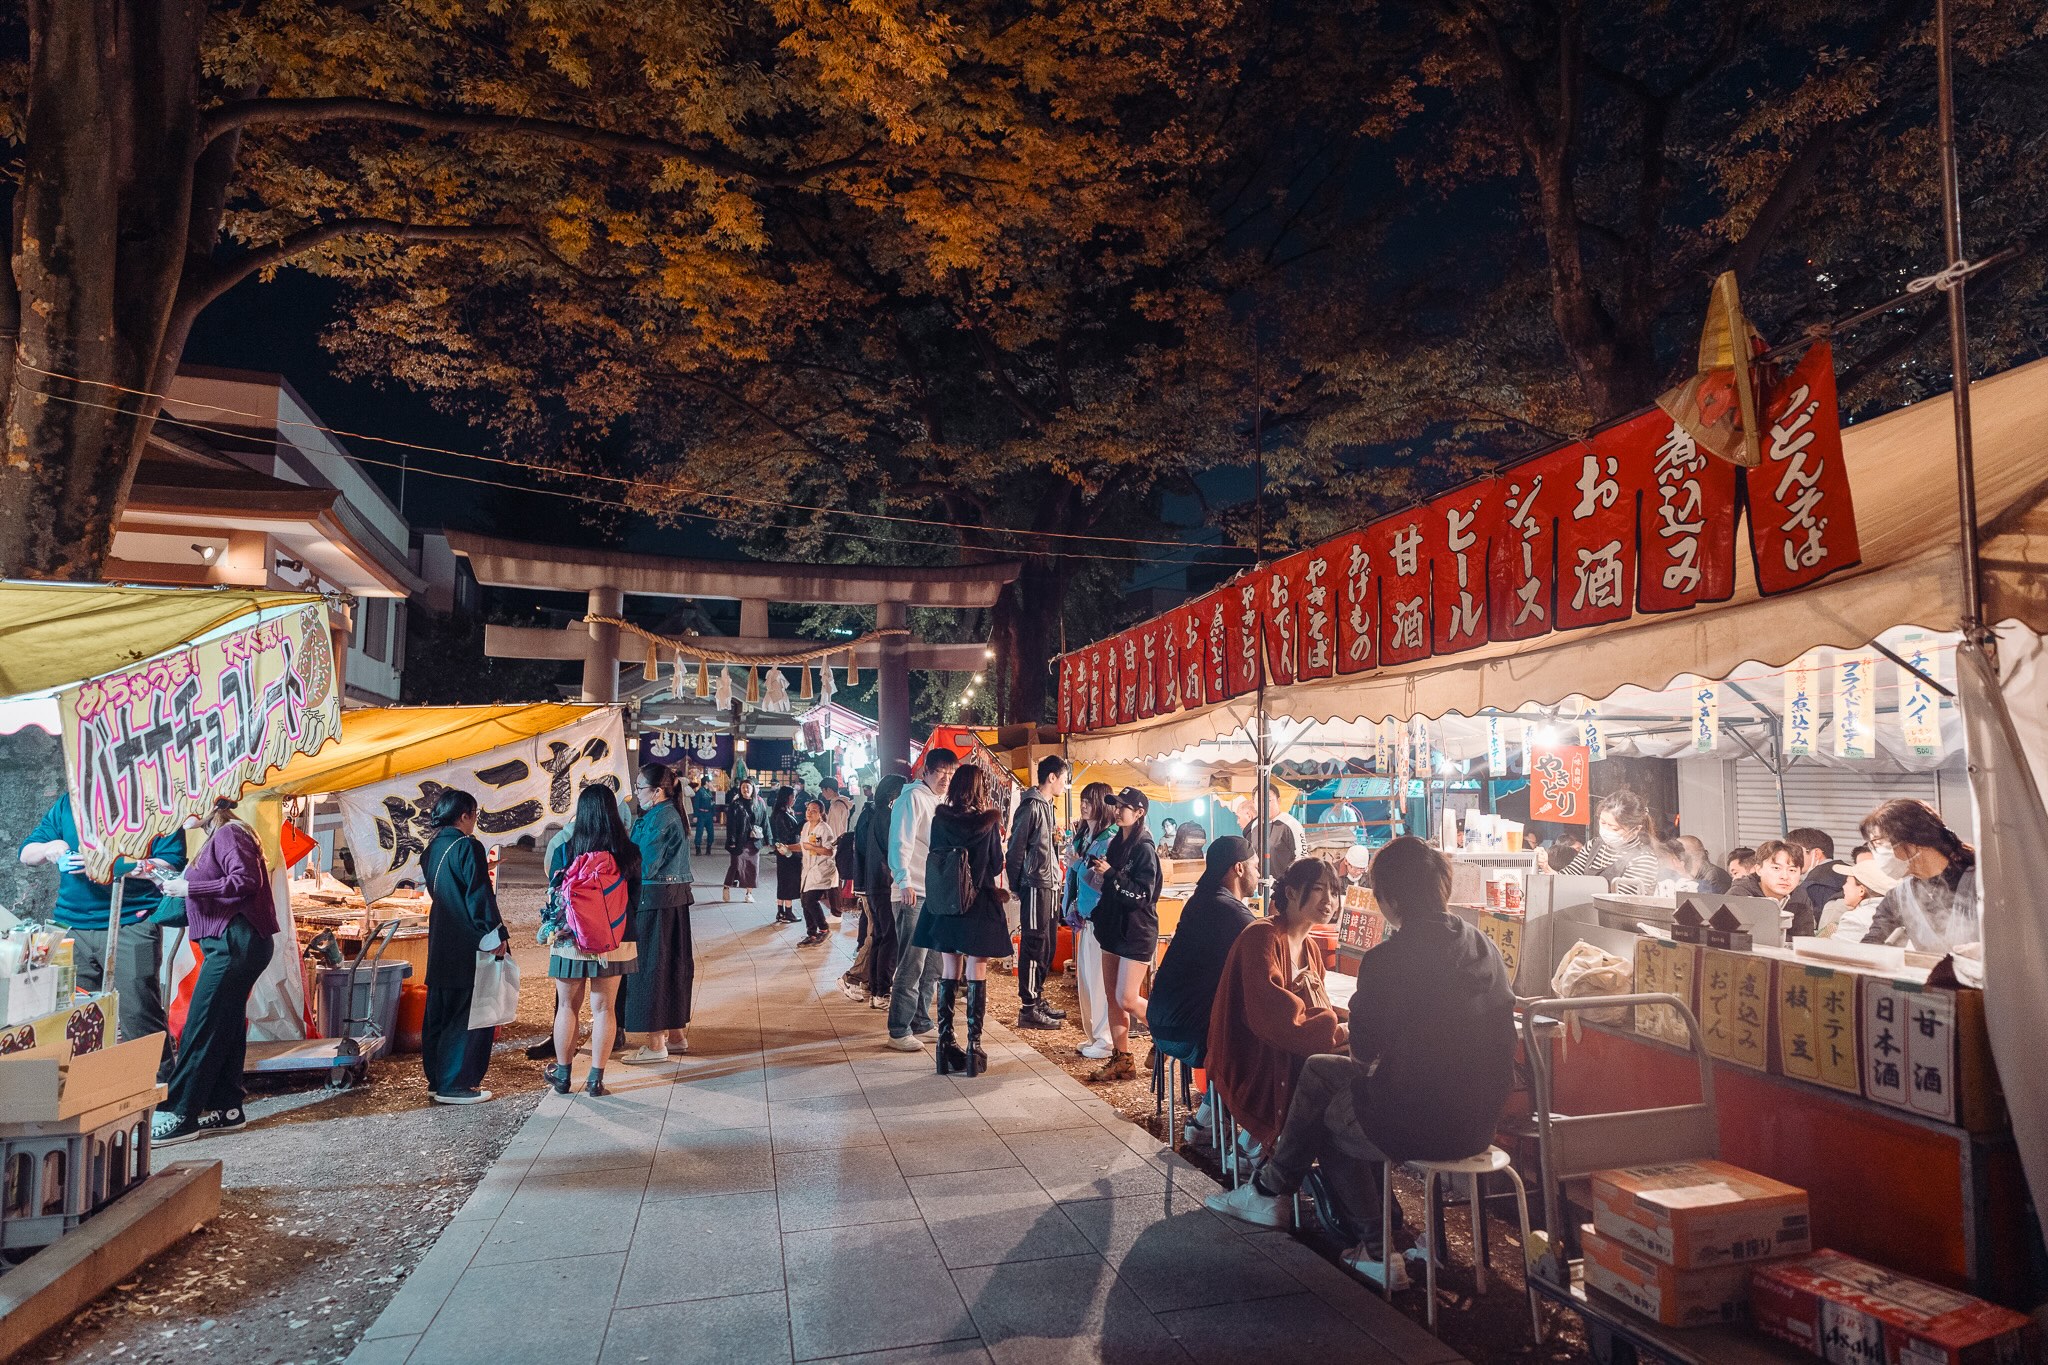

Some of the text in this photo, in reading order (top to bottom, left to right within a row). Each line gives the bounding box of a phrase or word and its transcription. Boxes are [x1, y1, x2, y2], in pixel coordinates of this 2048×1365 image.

[1504, 474, 1545, 626] ジュース
[1571, 453, 1624, 612] お酒
[1653, 421, 1708, 595] 煮込み
[1348, 544, 1372, 662] あげもの
[1389, 524, 1424, 650] 甘酒
[1446, 498, 1484, 641] ビール
[1241, 583, 1255, 683] やきとり
[1270, 574, 1293, 675] おでん
[1305, 557, 1330, 669] やきそば
[1124, 639, 1137, 714] 甘酒
[1143, 631, 1156, 712] ビール
[1163, 622, 1176, 706] ジュース
[1185, 615, 1200, 699] お酒
[78, 636, 306, 850] バナナチョコレート
[1791, 691, 1811, 746] 煮込み
[1534, 752, 1577, 819] やきとり
[1355, 915, 1368, 946] おでん
[1708, 970, 1729, 1040] おでん
[1737, 974, 1761, 1048] 煮込み
[1785, 985, 1814, 1062] 枝豆
[1823, 991, 1846, 1067] ポテト
[1873, 996, 1901, 1091] 日本酒
[1912, 1009, 1944, 1095] 甘酒
[1826, 1325, 1880, 1363] Asahi
